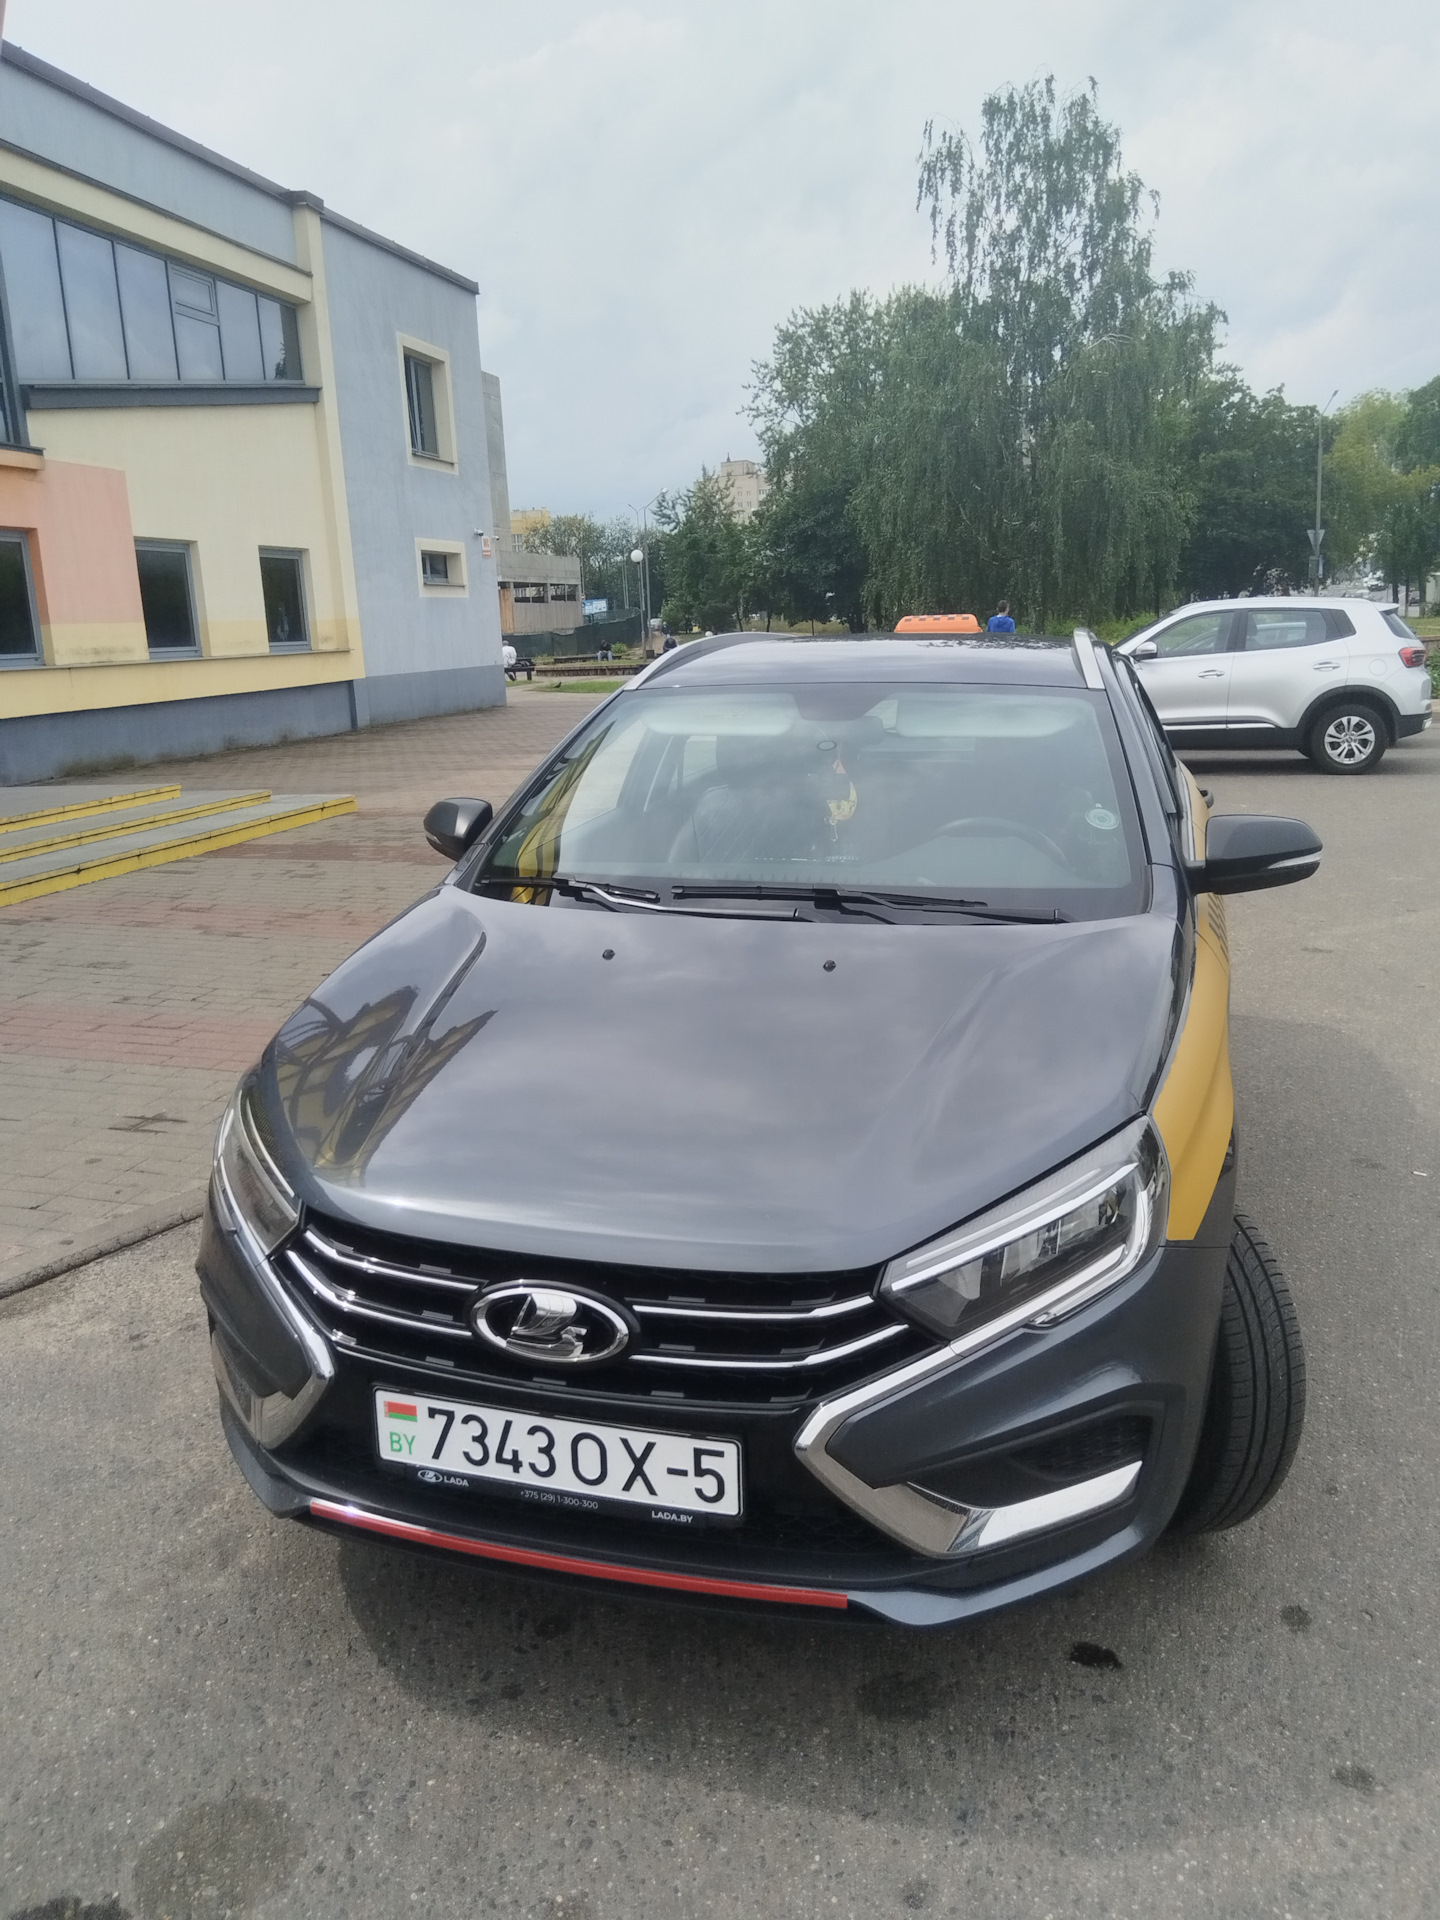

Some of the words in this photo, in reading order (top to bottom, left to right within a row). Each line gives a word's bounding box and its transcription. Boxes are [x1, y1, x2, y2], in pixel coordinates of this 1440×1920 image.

[389, 1431, 416, 1455] BY
[443, 1475, 469, 1487] LADA
[520, 1489, 539, 1499] +375
[540, 1492, 556, 1503] (29)
[557, 1495, 599, 1509] 1-300-300
[651, 1510, 693, 1523] LADA.BY
